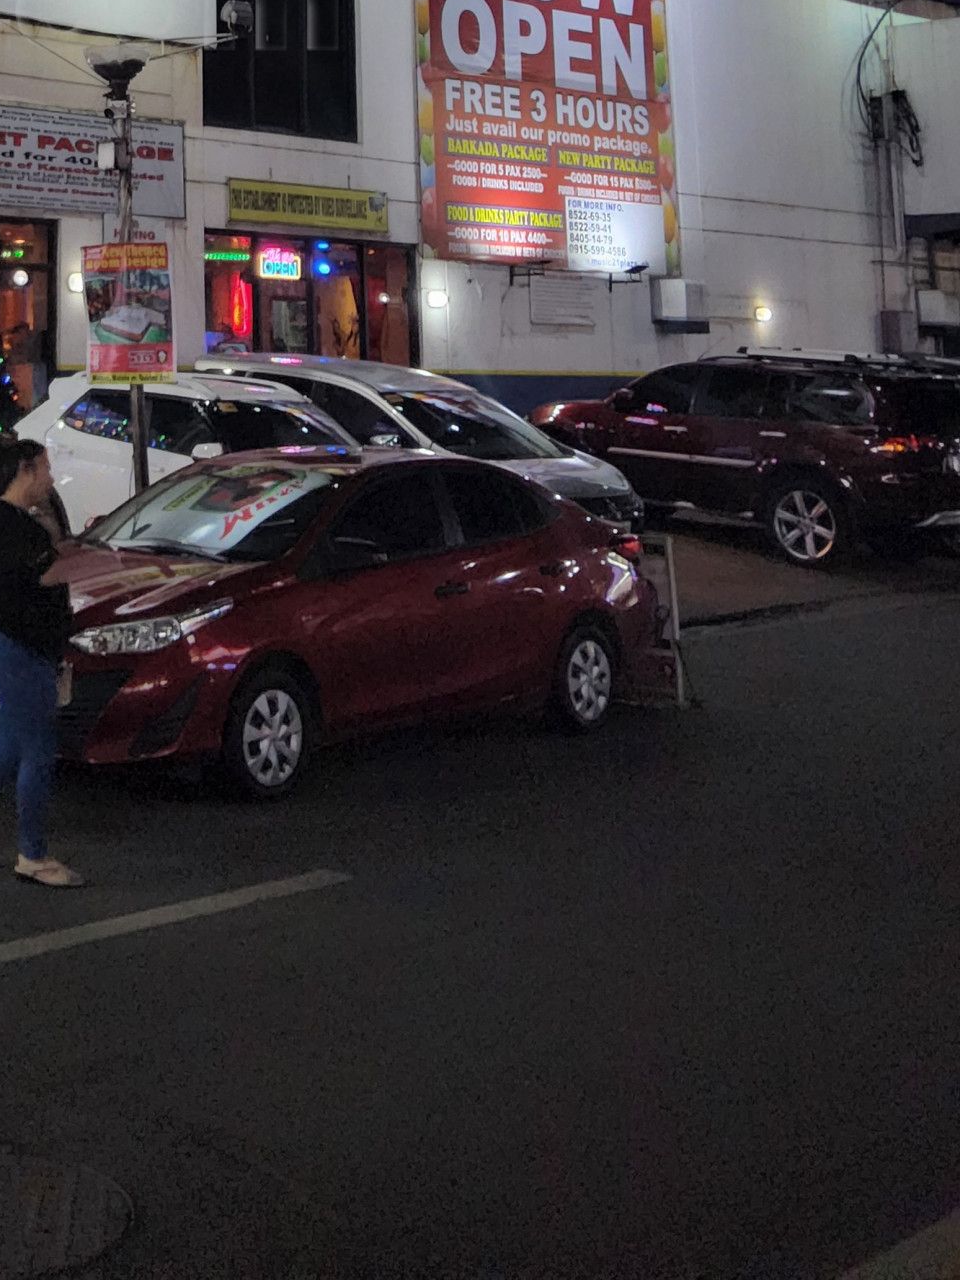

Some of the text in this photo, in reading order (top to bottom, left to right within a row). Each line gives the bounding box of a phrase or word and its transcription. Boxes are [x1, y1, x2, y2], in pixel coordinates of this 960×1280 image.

[444, 78, 650, 136] FREE 3 HOURS
[445, 114, 653, 157] Just avail our promo package.
[37, 134, 176, 163] PACGE
[447, 137, 549, 163] BARKADA PACKAGE
[24, 150, 56, 164] for
[558, 149, 657, 175] NEW PARTY PACKAGE
[17, 160, 34, 170] of
[36, 161, 100, 177] Karaoke
[480, 162, 497, 176] FOR
[498, 164, 505, 176] 5
[505, 164, 522, 178] PAX
[452, 175, 478, 188] FOODS
[481, 177, 508, 191] DRINKS
[509, 179, 544, 194] INCLUDED
[592, 173, 608, 187] FOR
[619, 176, 634, 189] PAX
[567, 199, 583, 209] FOR
[584, 200, 603, 211] MORE
[447, 205, 469, 221] FOOD
[475, 207, 504, 224] DRINKS
[505, 209, 529, 226] PARTY
[568, 209, 612, 222] 8522-69-35
[114, 229, 156, 241] HING
[480, 228, 498, 241] FOR
[510, 230, 527, 243] PAX
[264, 261, 297, 276] OPEN
